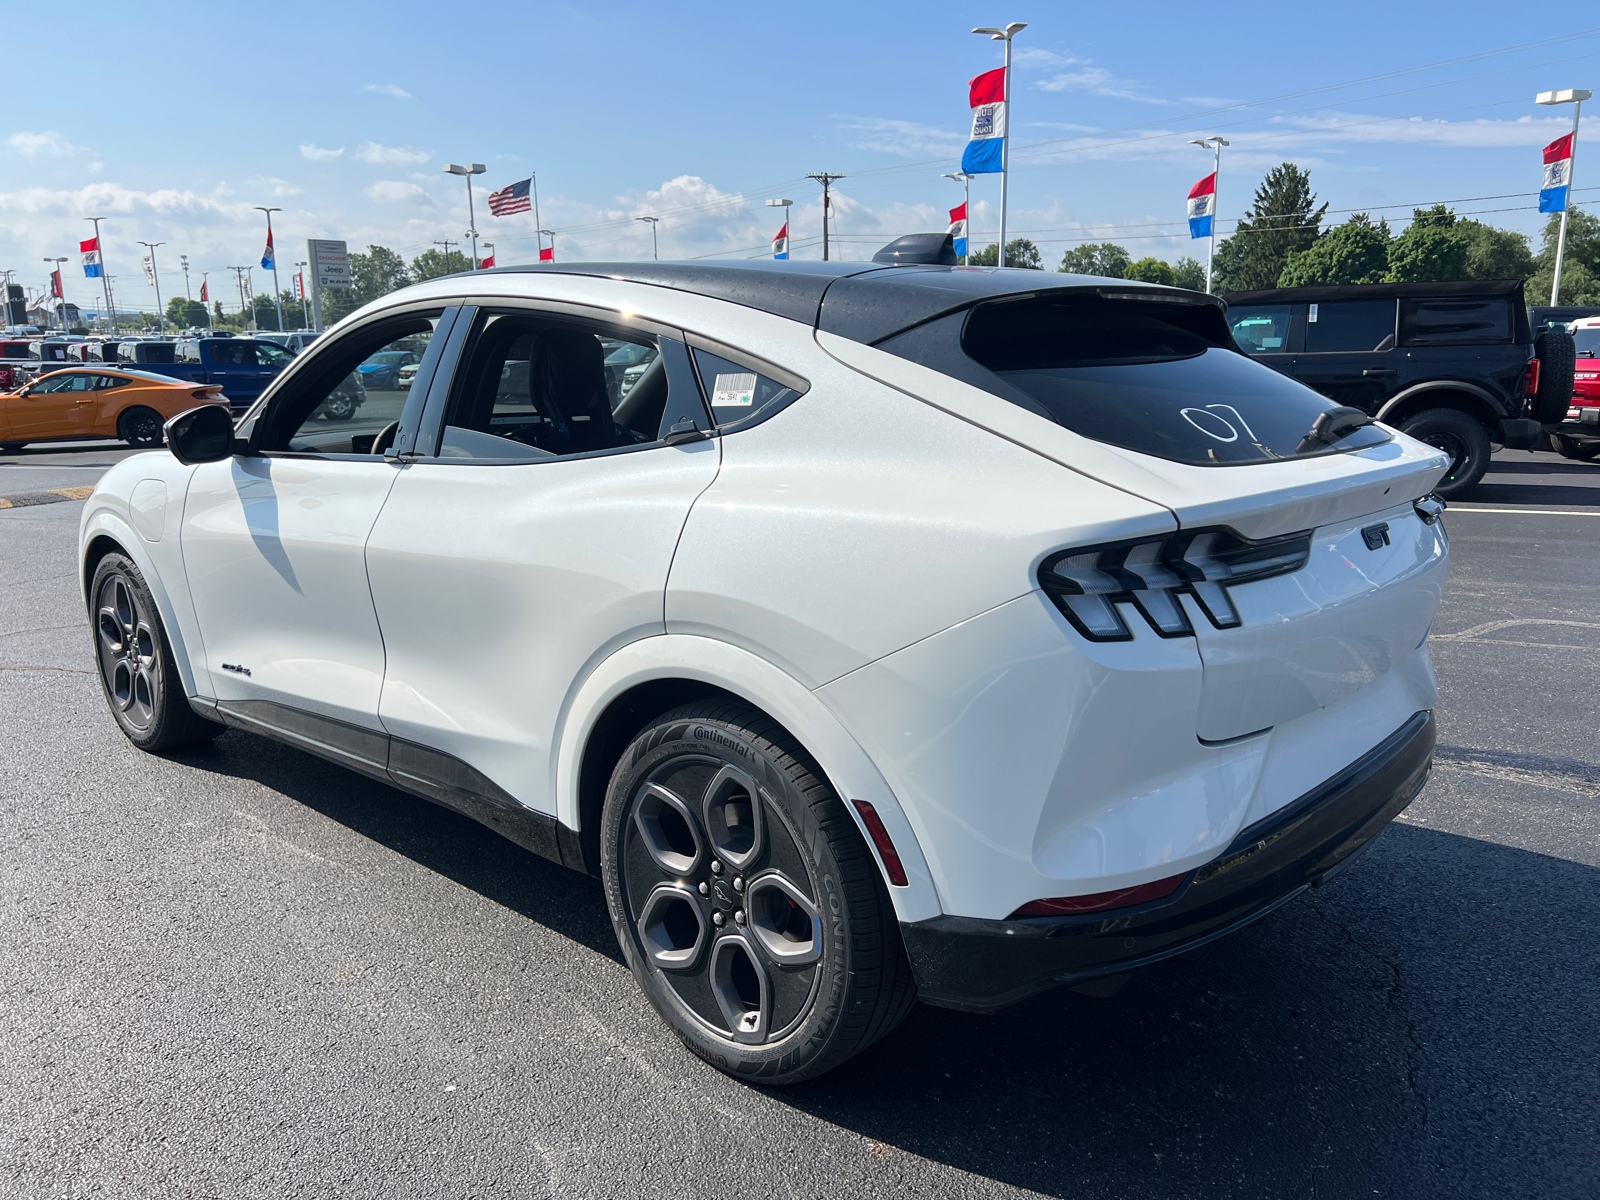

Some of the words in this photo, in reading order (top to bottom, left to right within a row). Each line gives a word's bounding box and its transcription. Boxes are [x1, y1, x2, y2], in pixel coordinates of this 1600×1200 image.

[324, 265, 344, 275] Jeep
[1361, 522, 1391, 552] GT
[692, 726, 748, 759] Continental
[804, 871, 845, 1055] CONTINENTAL
